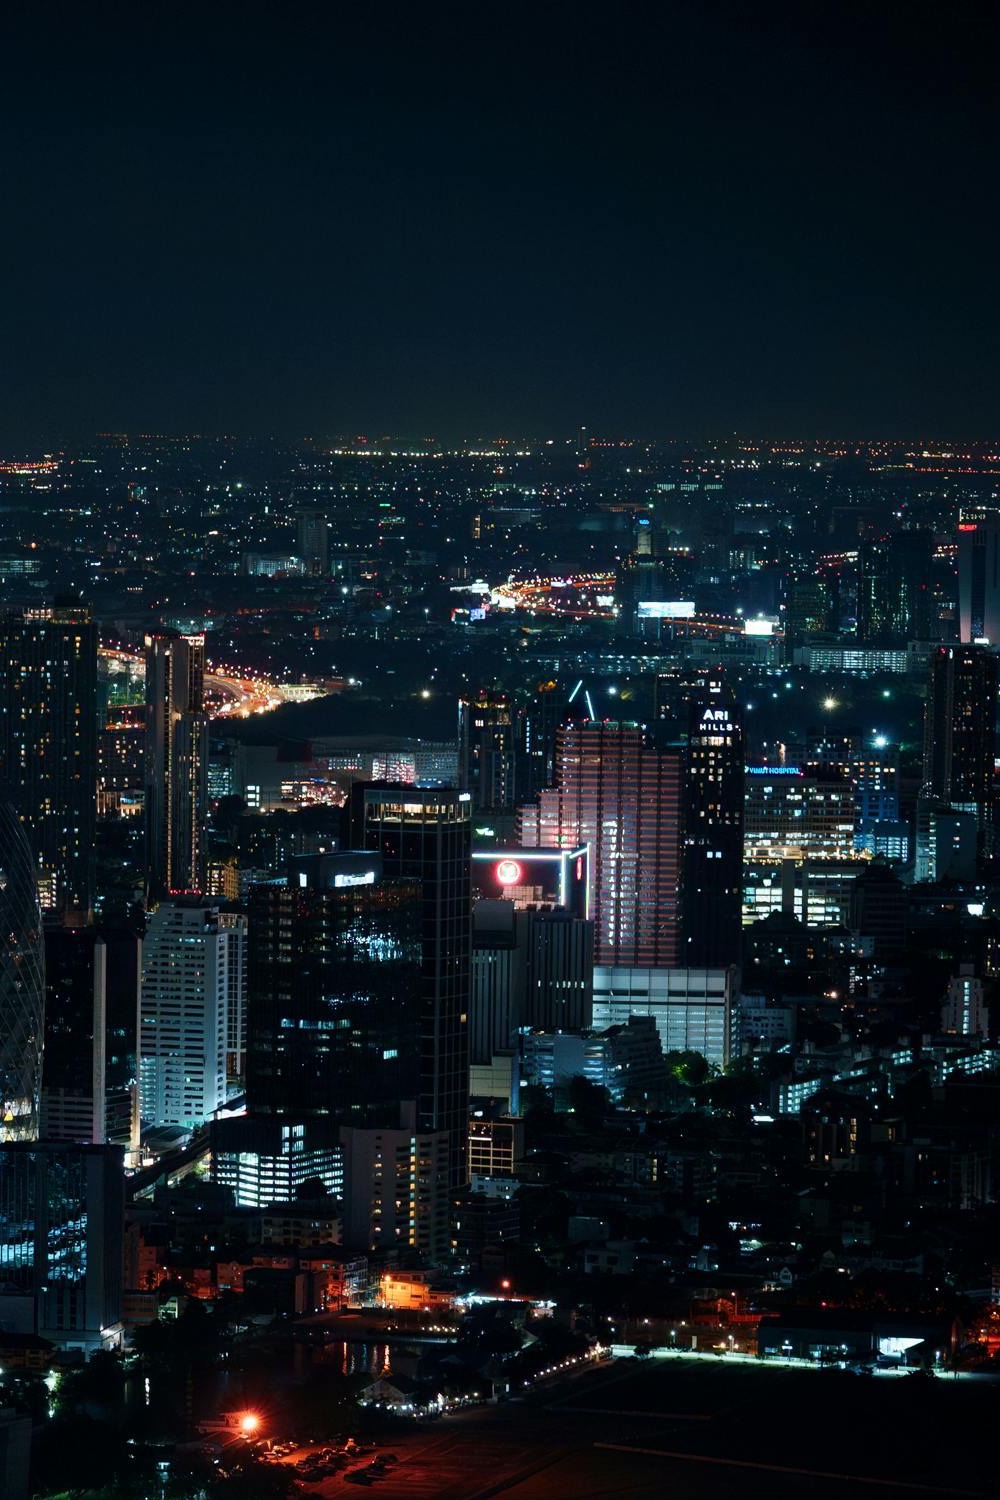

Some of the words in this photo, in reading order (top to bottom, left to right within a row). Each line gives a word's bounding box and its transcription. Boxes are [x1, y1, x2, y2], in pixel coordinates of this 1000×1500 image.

[703, 709, 729, 721] ARI
[700, 723, 733, 731] HILLS
[769, 767, 800, 775] HOSPITAL
